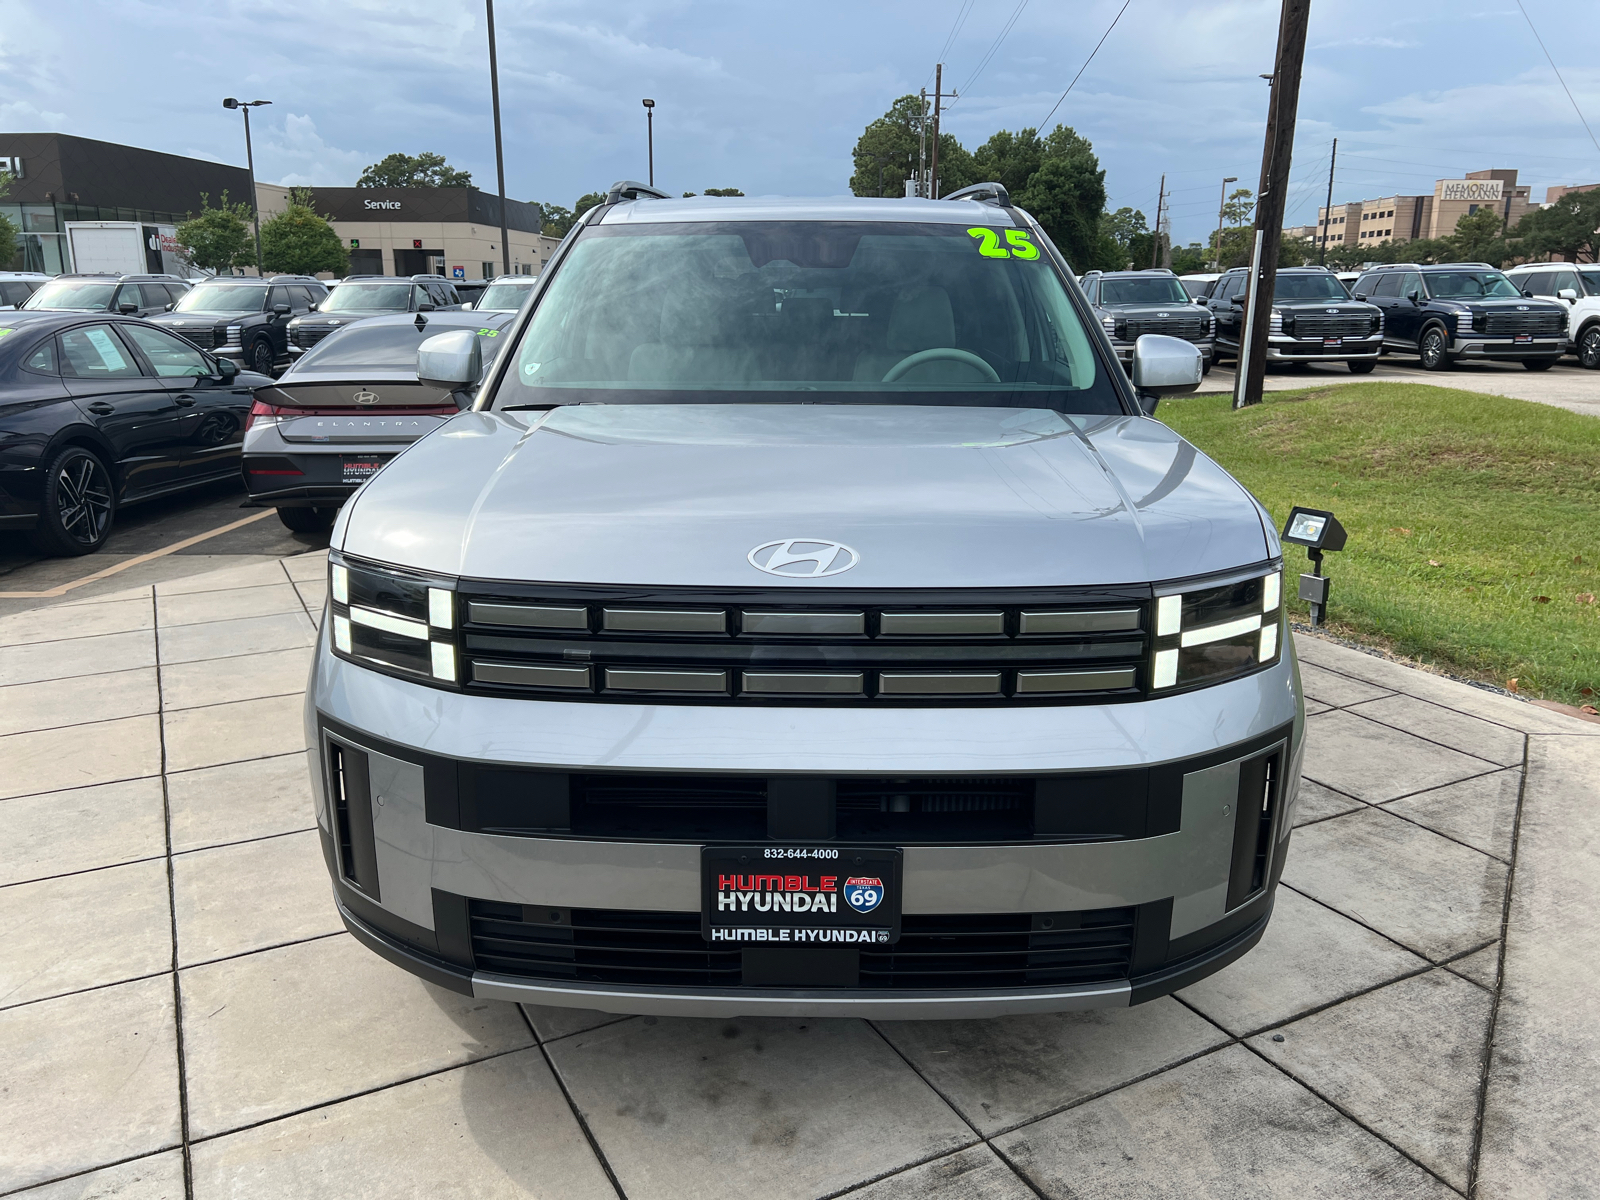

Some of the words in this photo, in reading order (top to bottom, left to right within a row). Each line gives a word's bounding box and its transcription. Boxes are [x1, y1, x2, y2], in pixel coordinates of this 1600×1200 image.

[1445, 183, 1501, 192] MEMORIAL
[1444, 191, 1500, 199] HERMANN
[364, 199, 401, 210] Service
[966, 227, 1041, 261] 25
[476, 328, 500, 338] 25
[763, 848, 839, 859] 832-644-4000
[718, 874, 838, 892] HUMBLE
[717, 891, 838, 913] HYUNDAI
[850, 889, 878, 907] 69
[711, 928, 791, 941] HUMBLE
[794, 929, 876, 943] HYUNDAI
